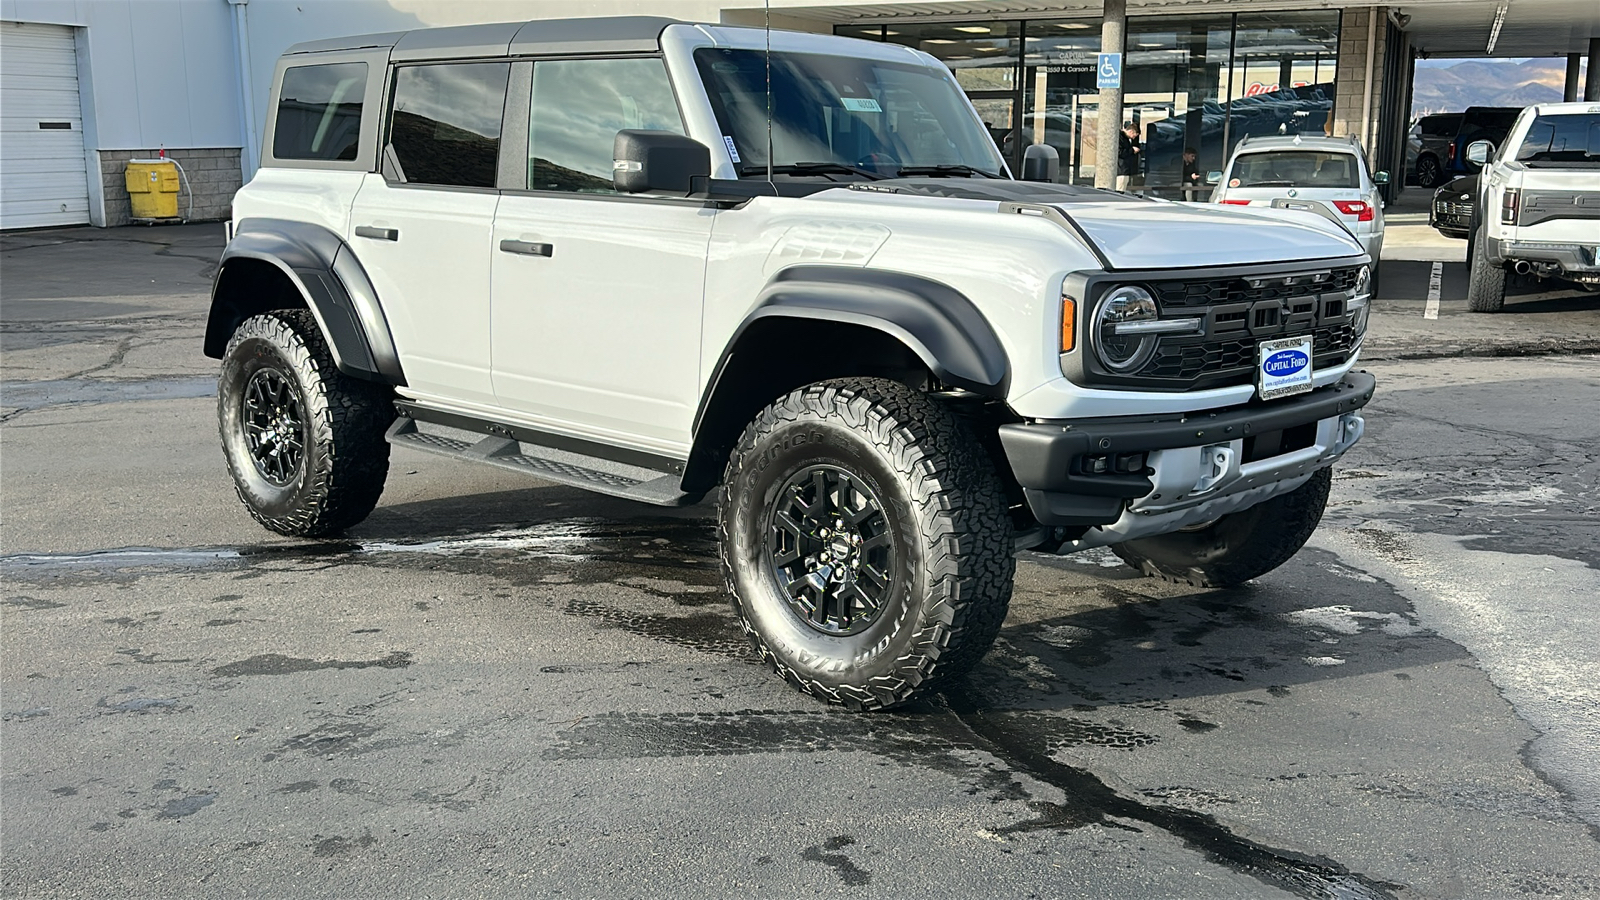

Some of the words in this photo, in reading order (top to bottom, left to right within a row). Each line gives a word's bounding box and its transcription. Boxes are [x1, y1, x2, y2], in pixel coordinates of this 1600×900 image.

[1206, 291, 1348, 340] FORD
[1272, 340, 1289, 349] CAPITAL
[1290, 338, 1302, 346] FORD
